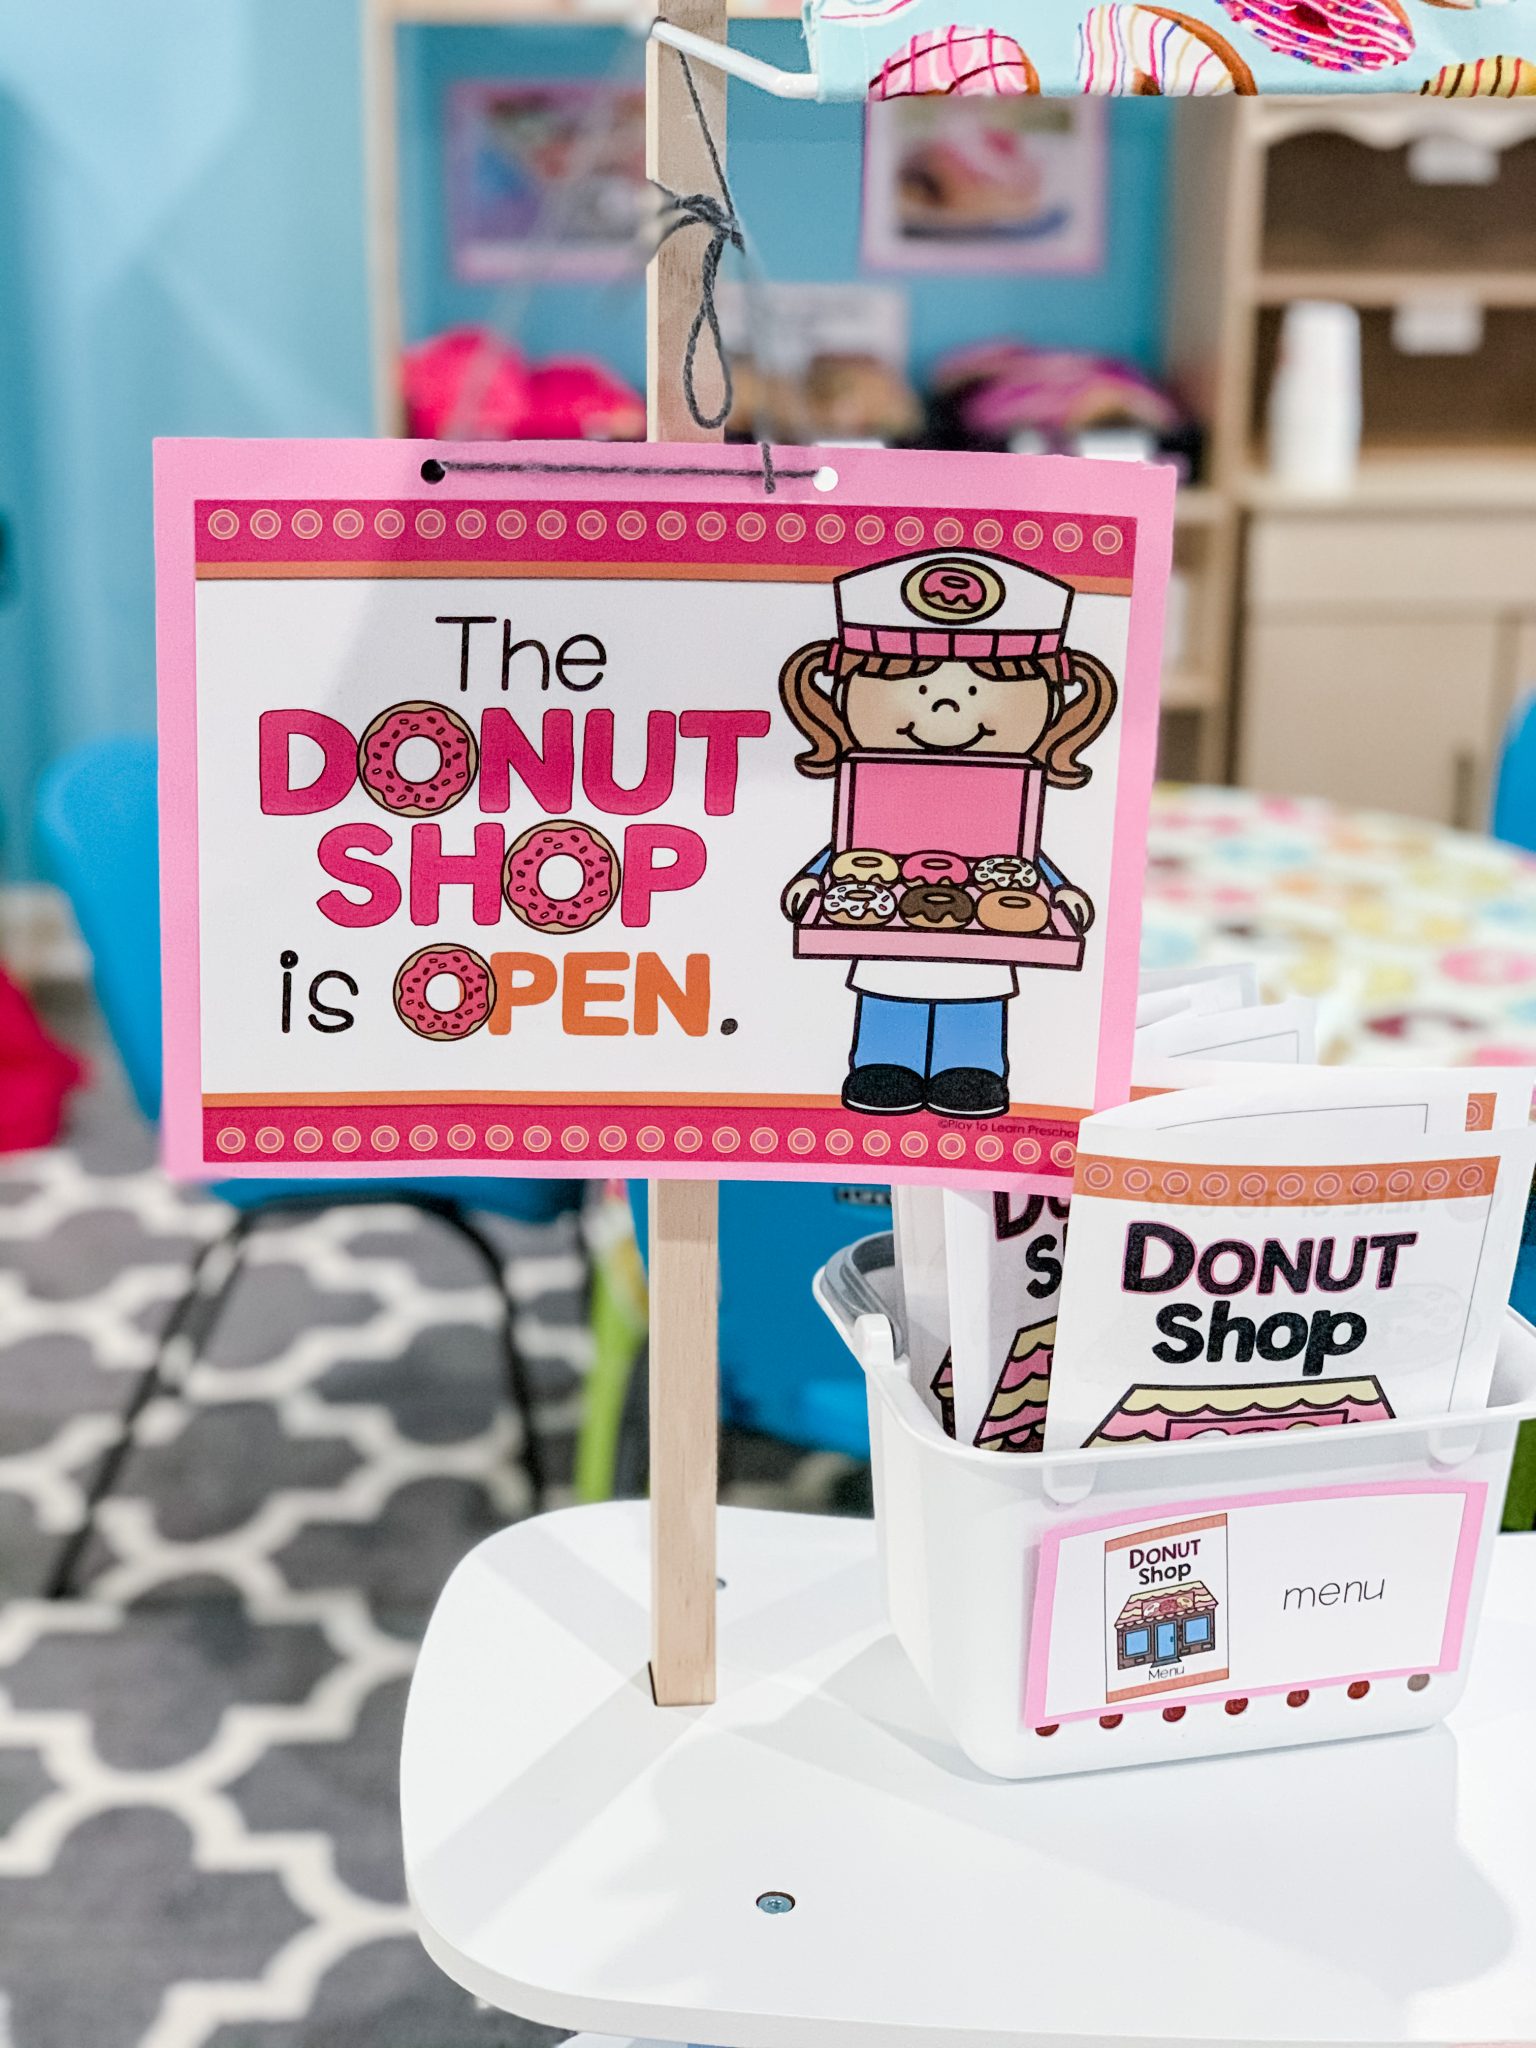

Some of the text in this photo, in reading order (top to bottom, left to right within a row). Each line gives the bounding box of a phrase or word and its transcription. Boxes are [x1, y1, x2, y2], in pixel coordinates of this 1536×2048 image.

[435, 616, 608, 692] The
[259, 700, 772, 818] DONUT
[316, 818, 708, 935] SHOP
[280, 942, 739, 1041] is OPEN.
[976, 1121, 988, 1132] to
[991, 1123, 1025, 1134] Learn
[1025, 1223, 1068, 1299] S
[1121, 1220, 1419, 1295] DONUT
[1152, 1300, 1368, 1376] Shop
[1129, 1539, 1201, 1569] DONUT
[1138, 1563, 1192, 1585] Shop
[1283, 1578, 1385, 1610] menu
[1148, 1666, 1185, 1681] Menu
